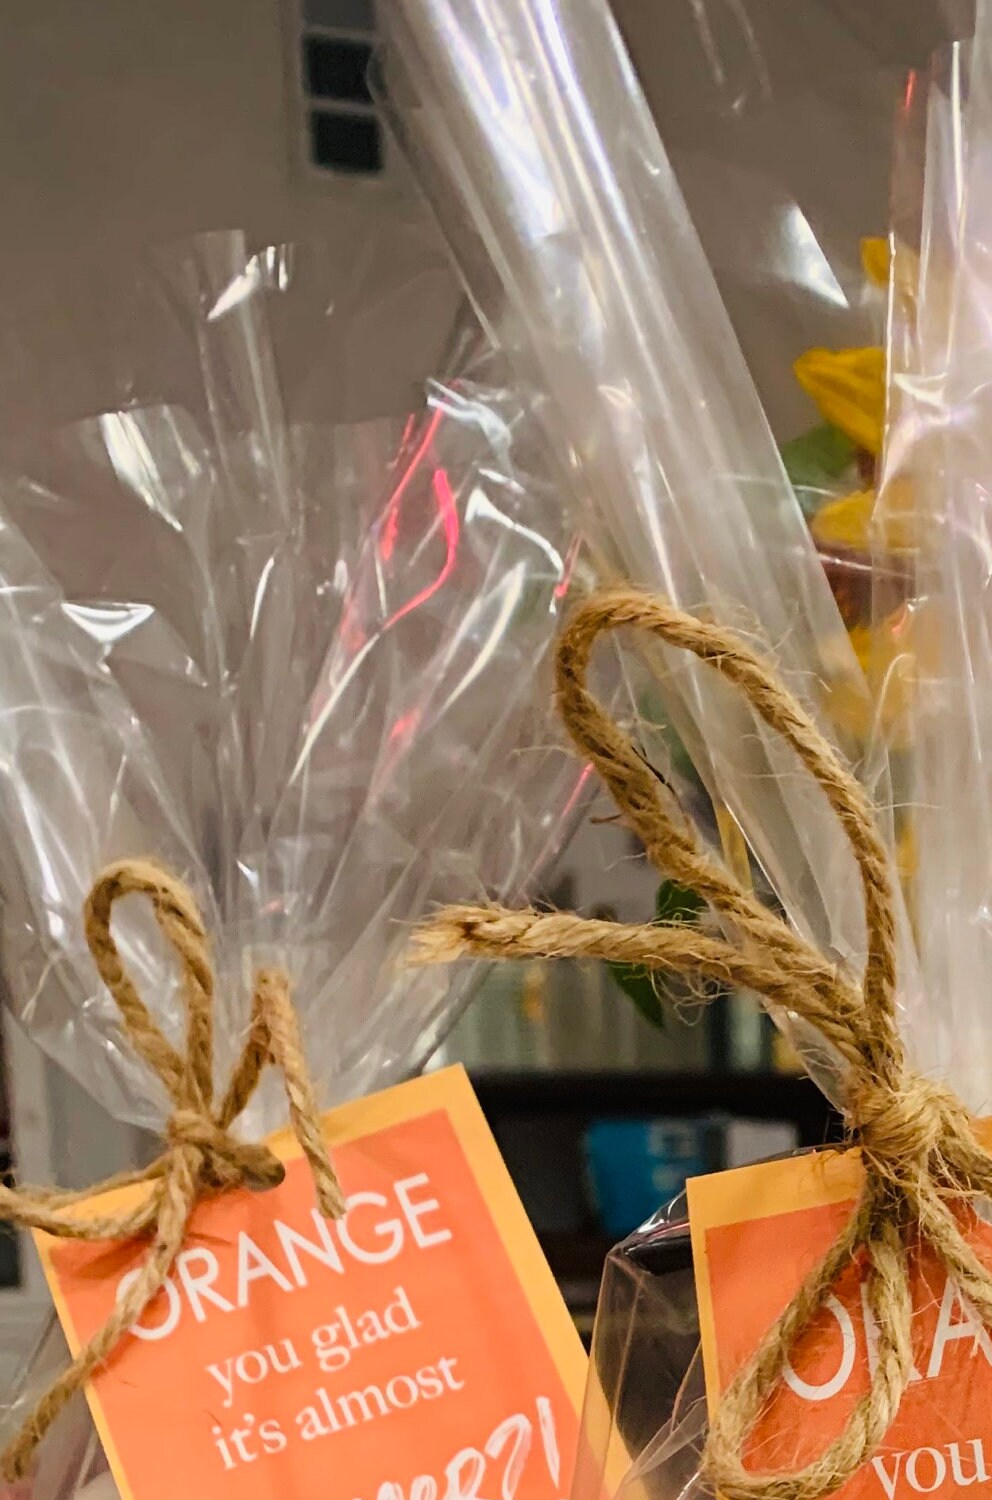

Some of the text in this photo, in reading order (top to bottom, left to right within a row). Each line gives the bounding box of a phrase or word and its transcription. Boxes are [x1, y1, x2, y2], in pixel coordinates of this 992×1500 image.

[116, 1173, 452, 1341] ORANGE
[206, 1286, 422, 1408] you glad
[211, 1356, 465, 1470] it's almost
